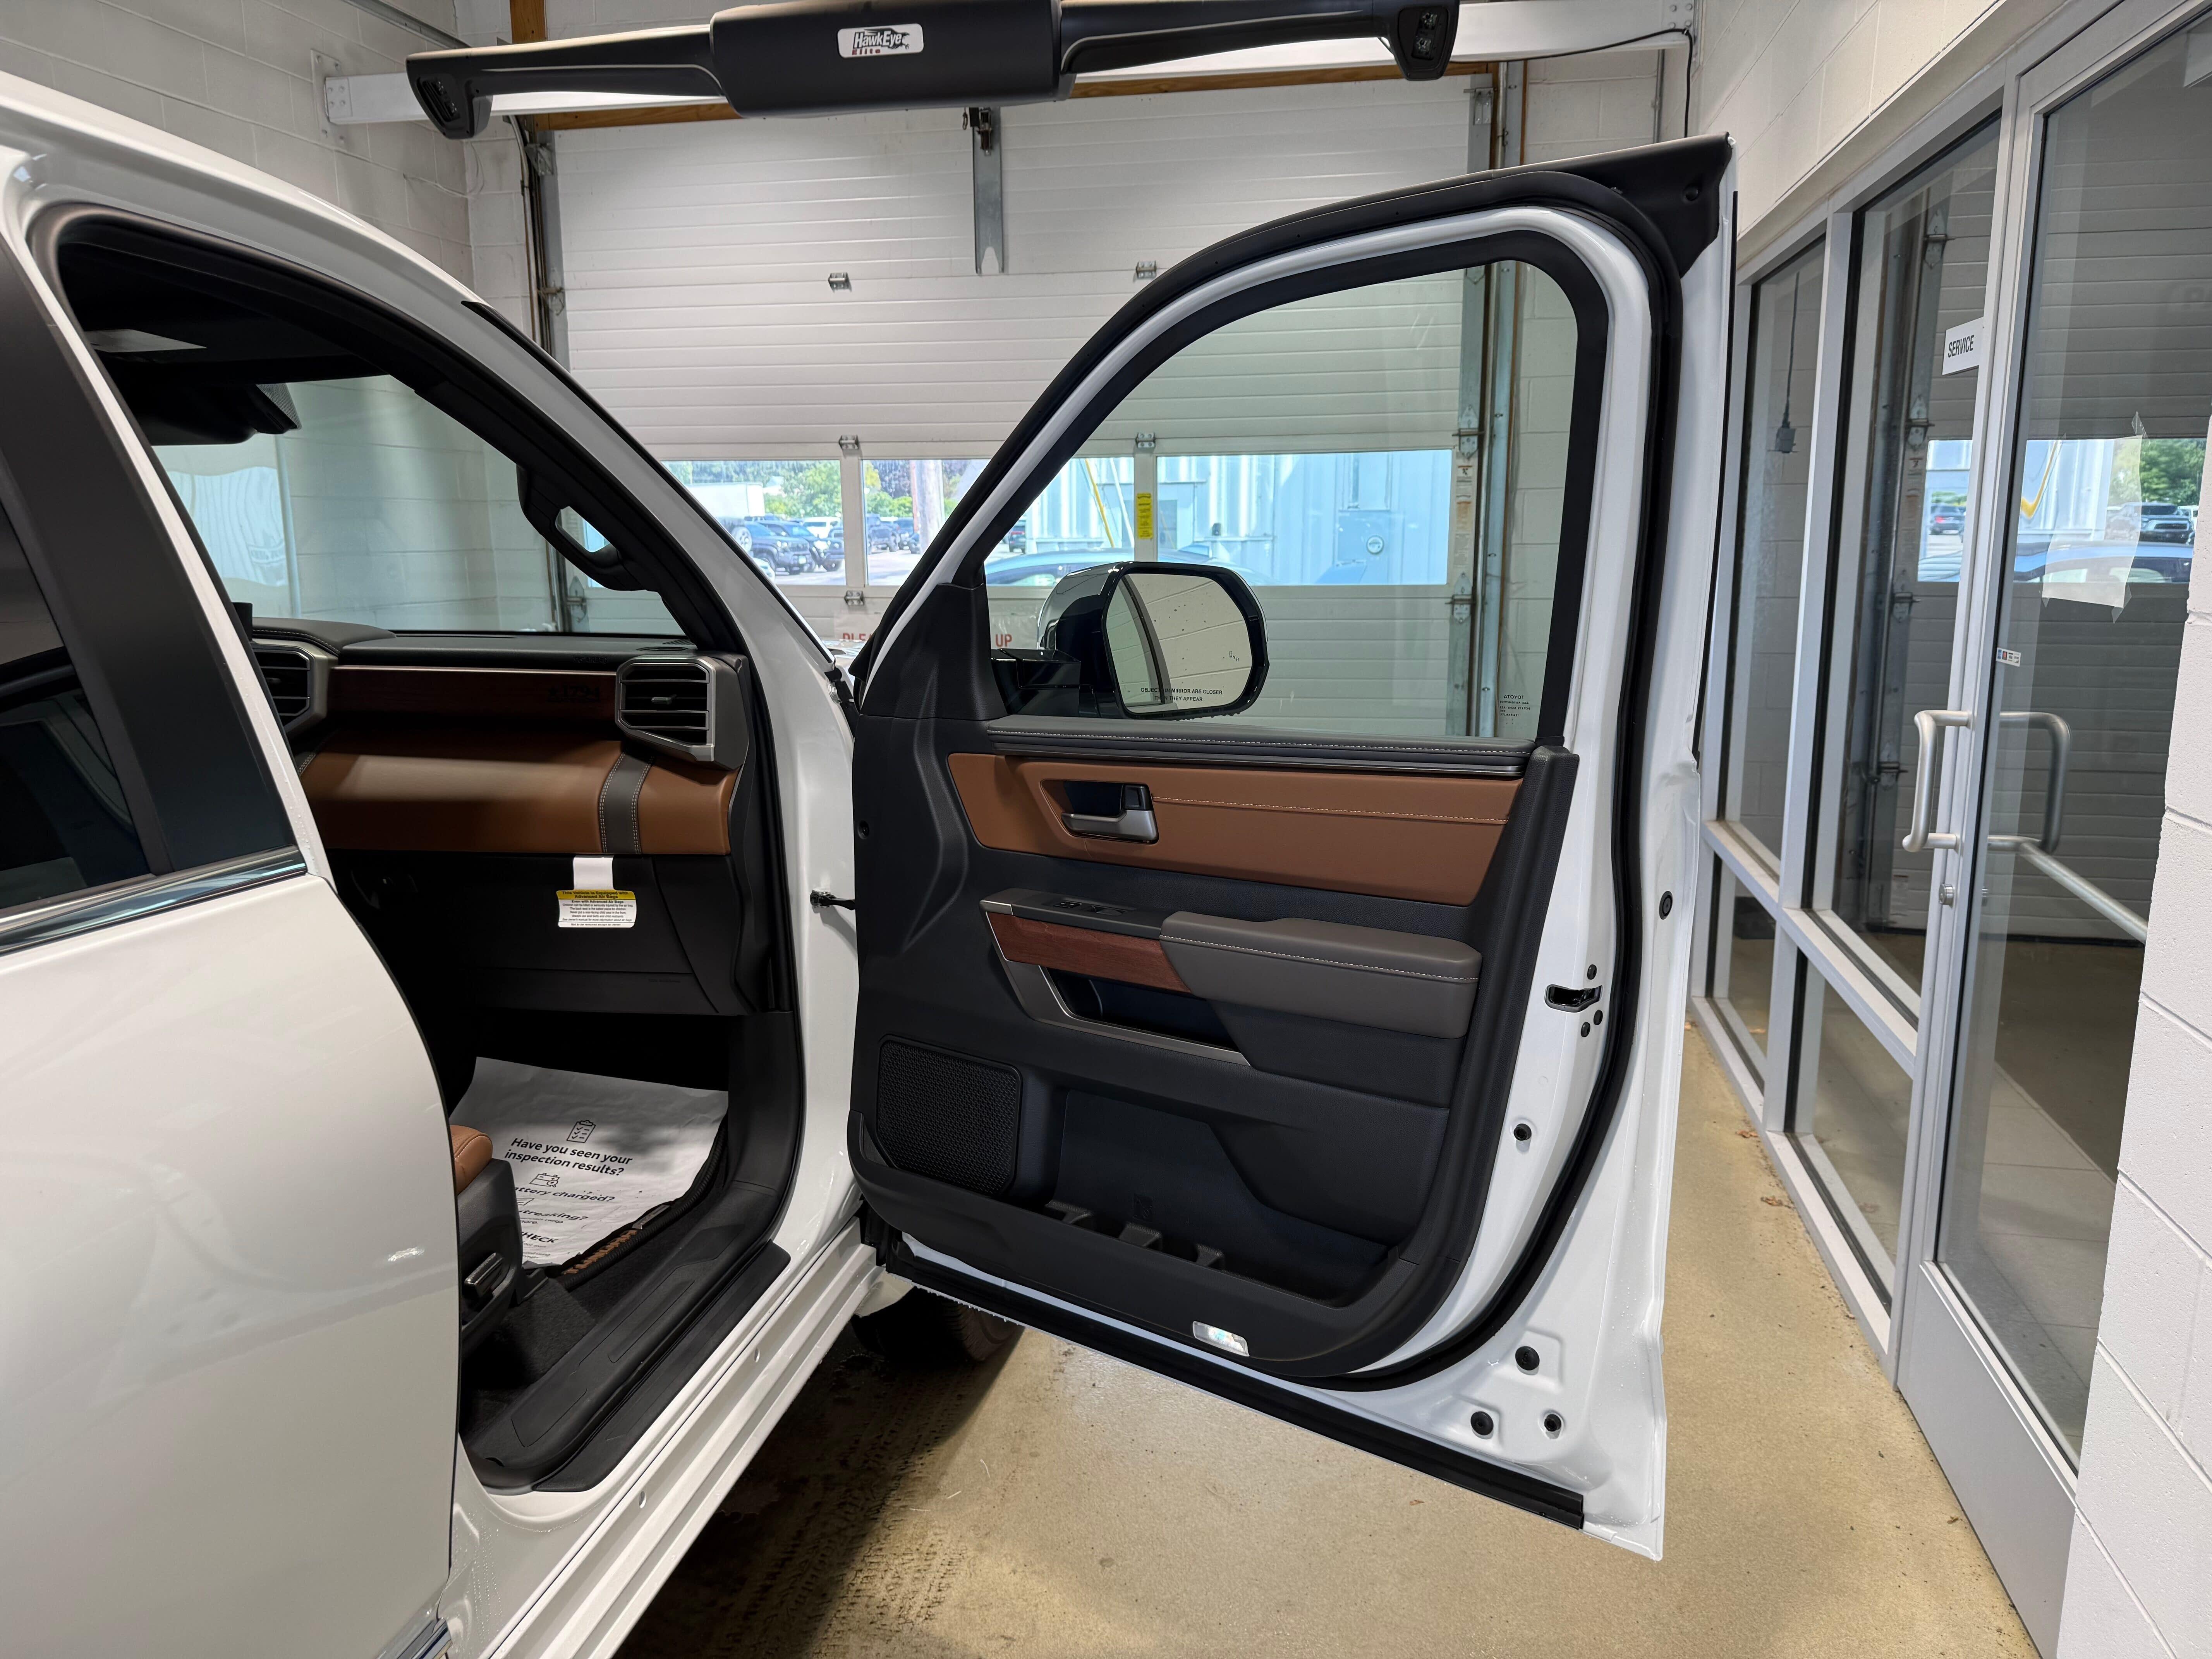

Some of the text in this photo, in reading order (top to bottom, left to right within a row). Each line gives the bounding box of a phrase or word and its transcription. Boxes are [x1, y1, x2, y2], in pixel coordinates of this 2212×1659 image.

[853, 30, 902, 48] HawkEye
[1948, 334, 1975, 358] SERVICE
[995, 634, 1013, 647] UP
[511, 1137, 633, 1165] Have you seen your
[504, 1149, 624, 1176] inspection results?
[553, 1191, 615, 1202] charged?
[519, 1210, 589, 1220] treaking?
[521, 1231, 559, 1243] HECK
